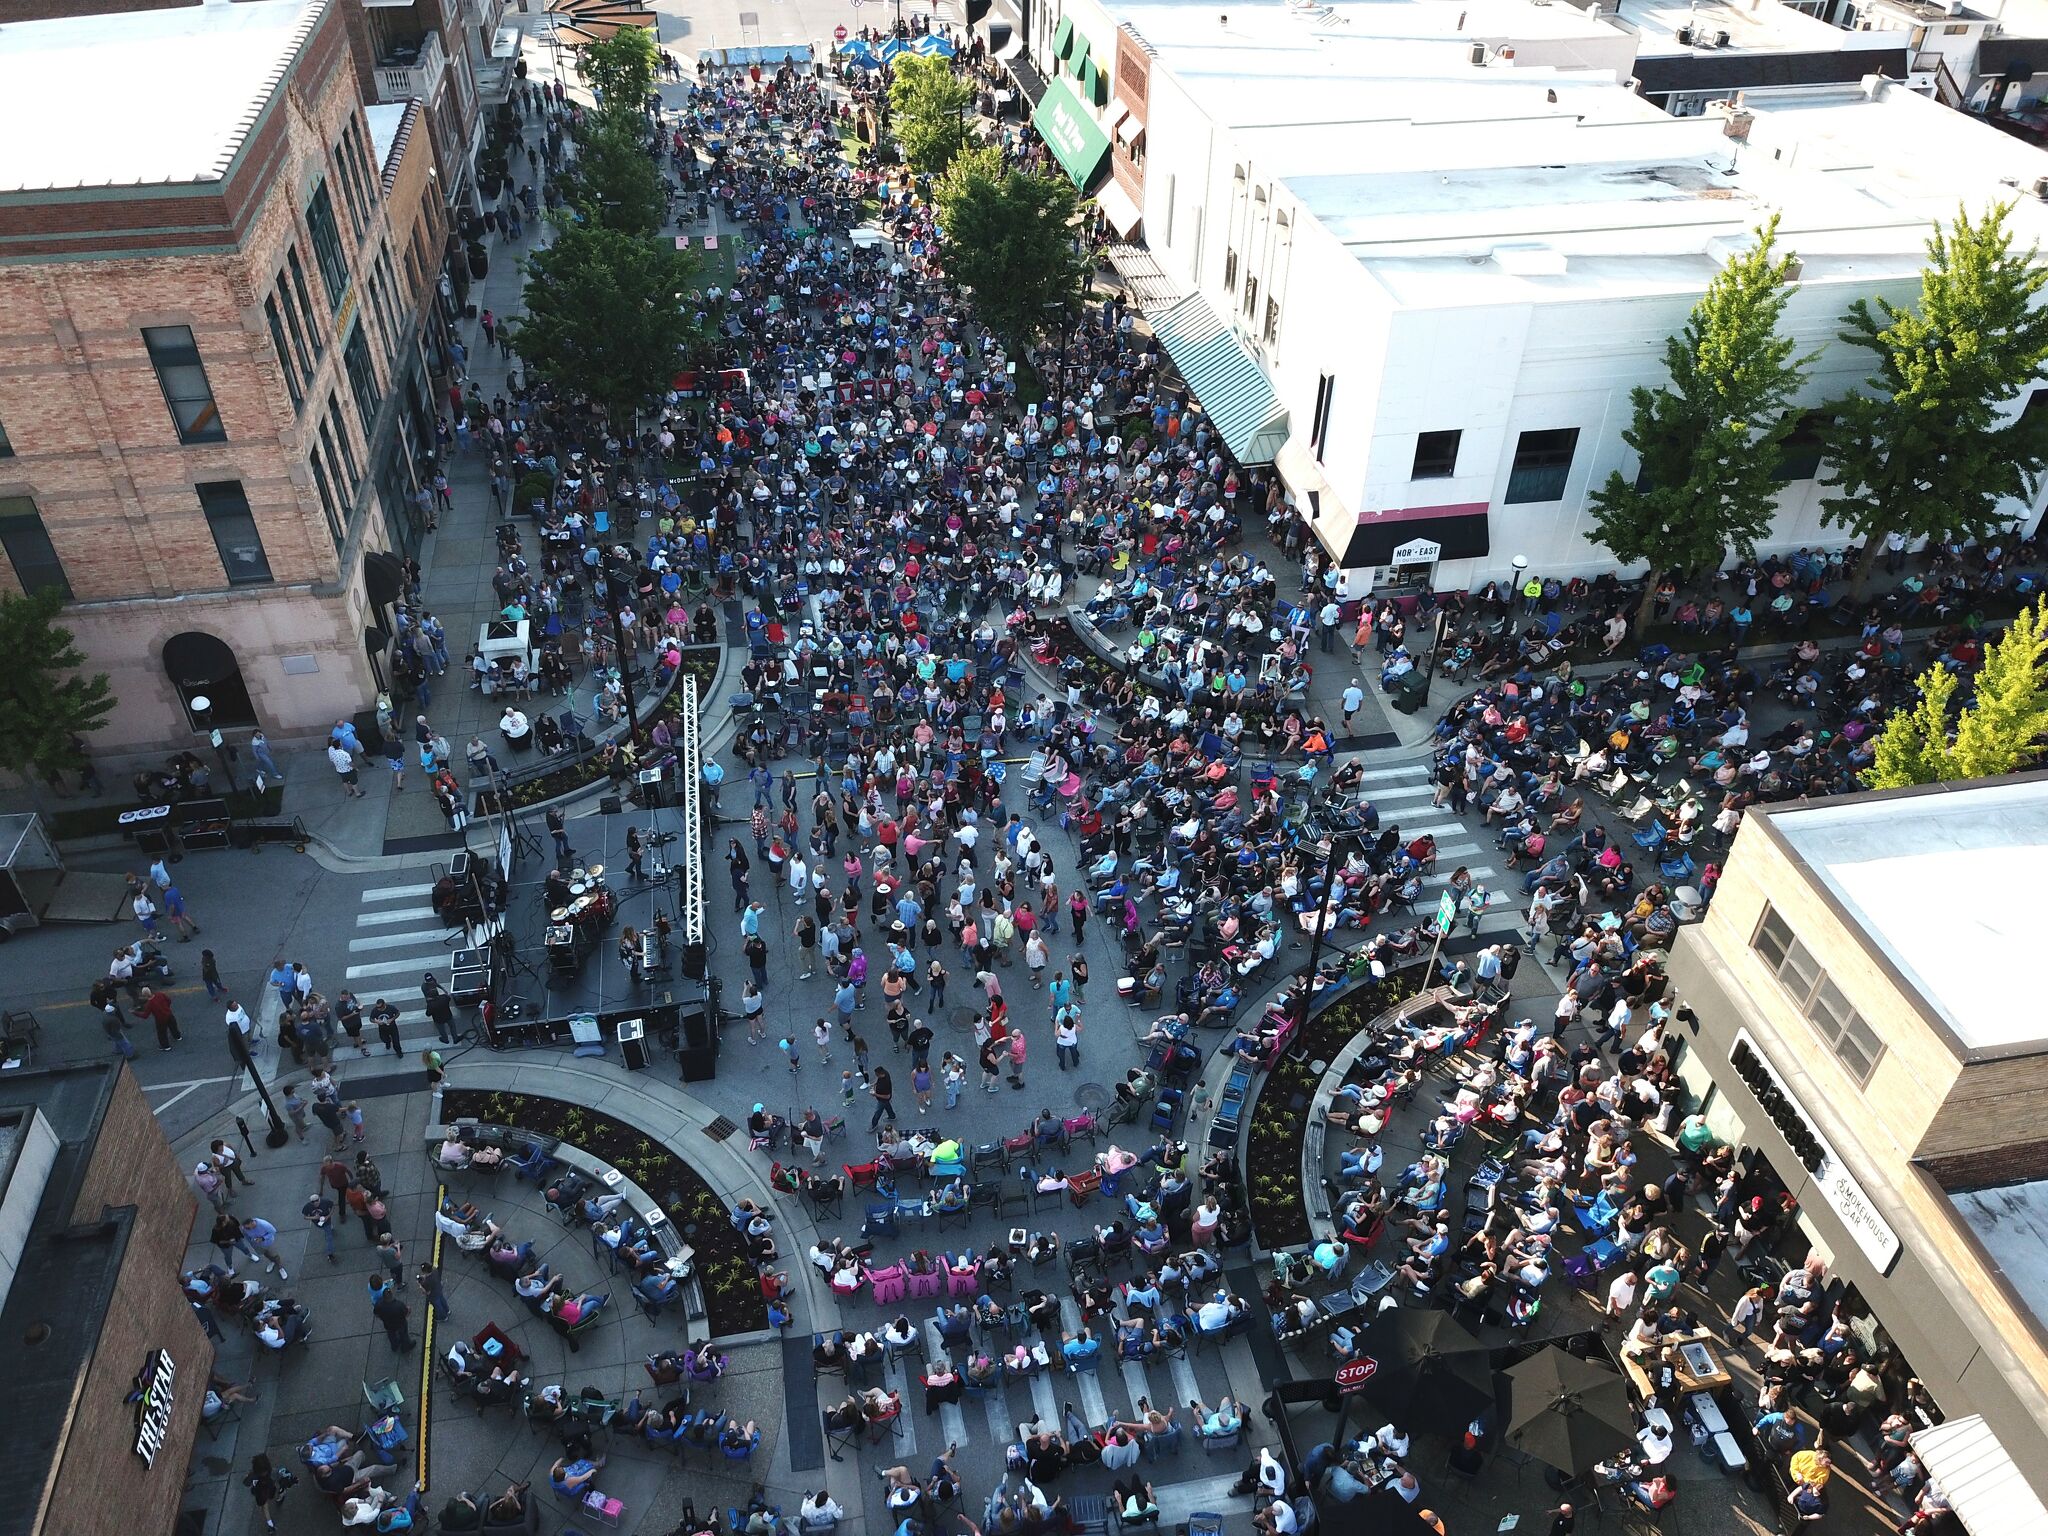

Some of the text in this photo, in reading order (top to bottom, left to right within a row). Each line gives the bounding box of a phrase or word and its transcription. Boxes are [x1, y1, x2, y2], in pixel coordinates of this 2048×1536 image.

[1836, 1178, 1890, 1249] SMOKEHOUSE
[1338, 1363, 1375, 1380] STOP
[136, 1347, 175, 1464] TRI-STAR
[155, 1392, 174, 1451] TRUST
